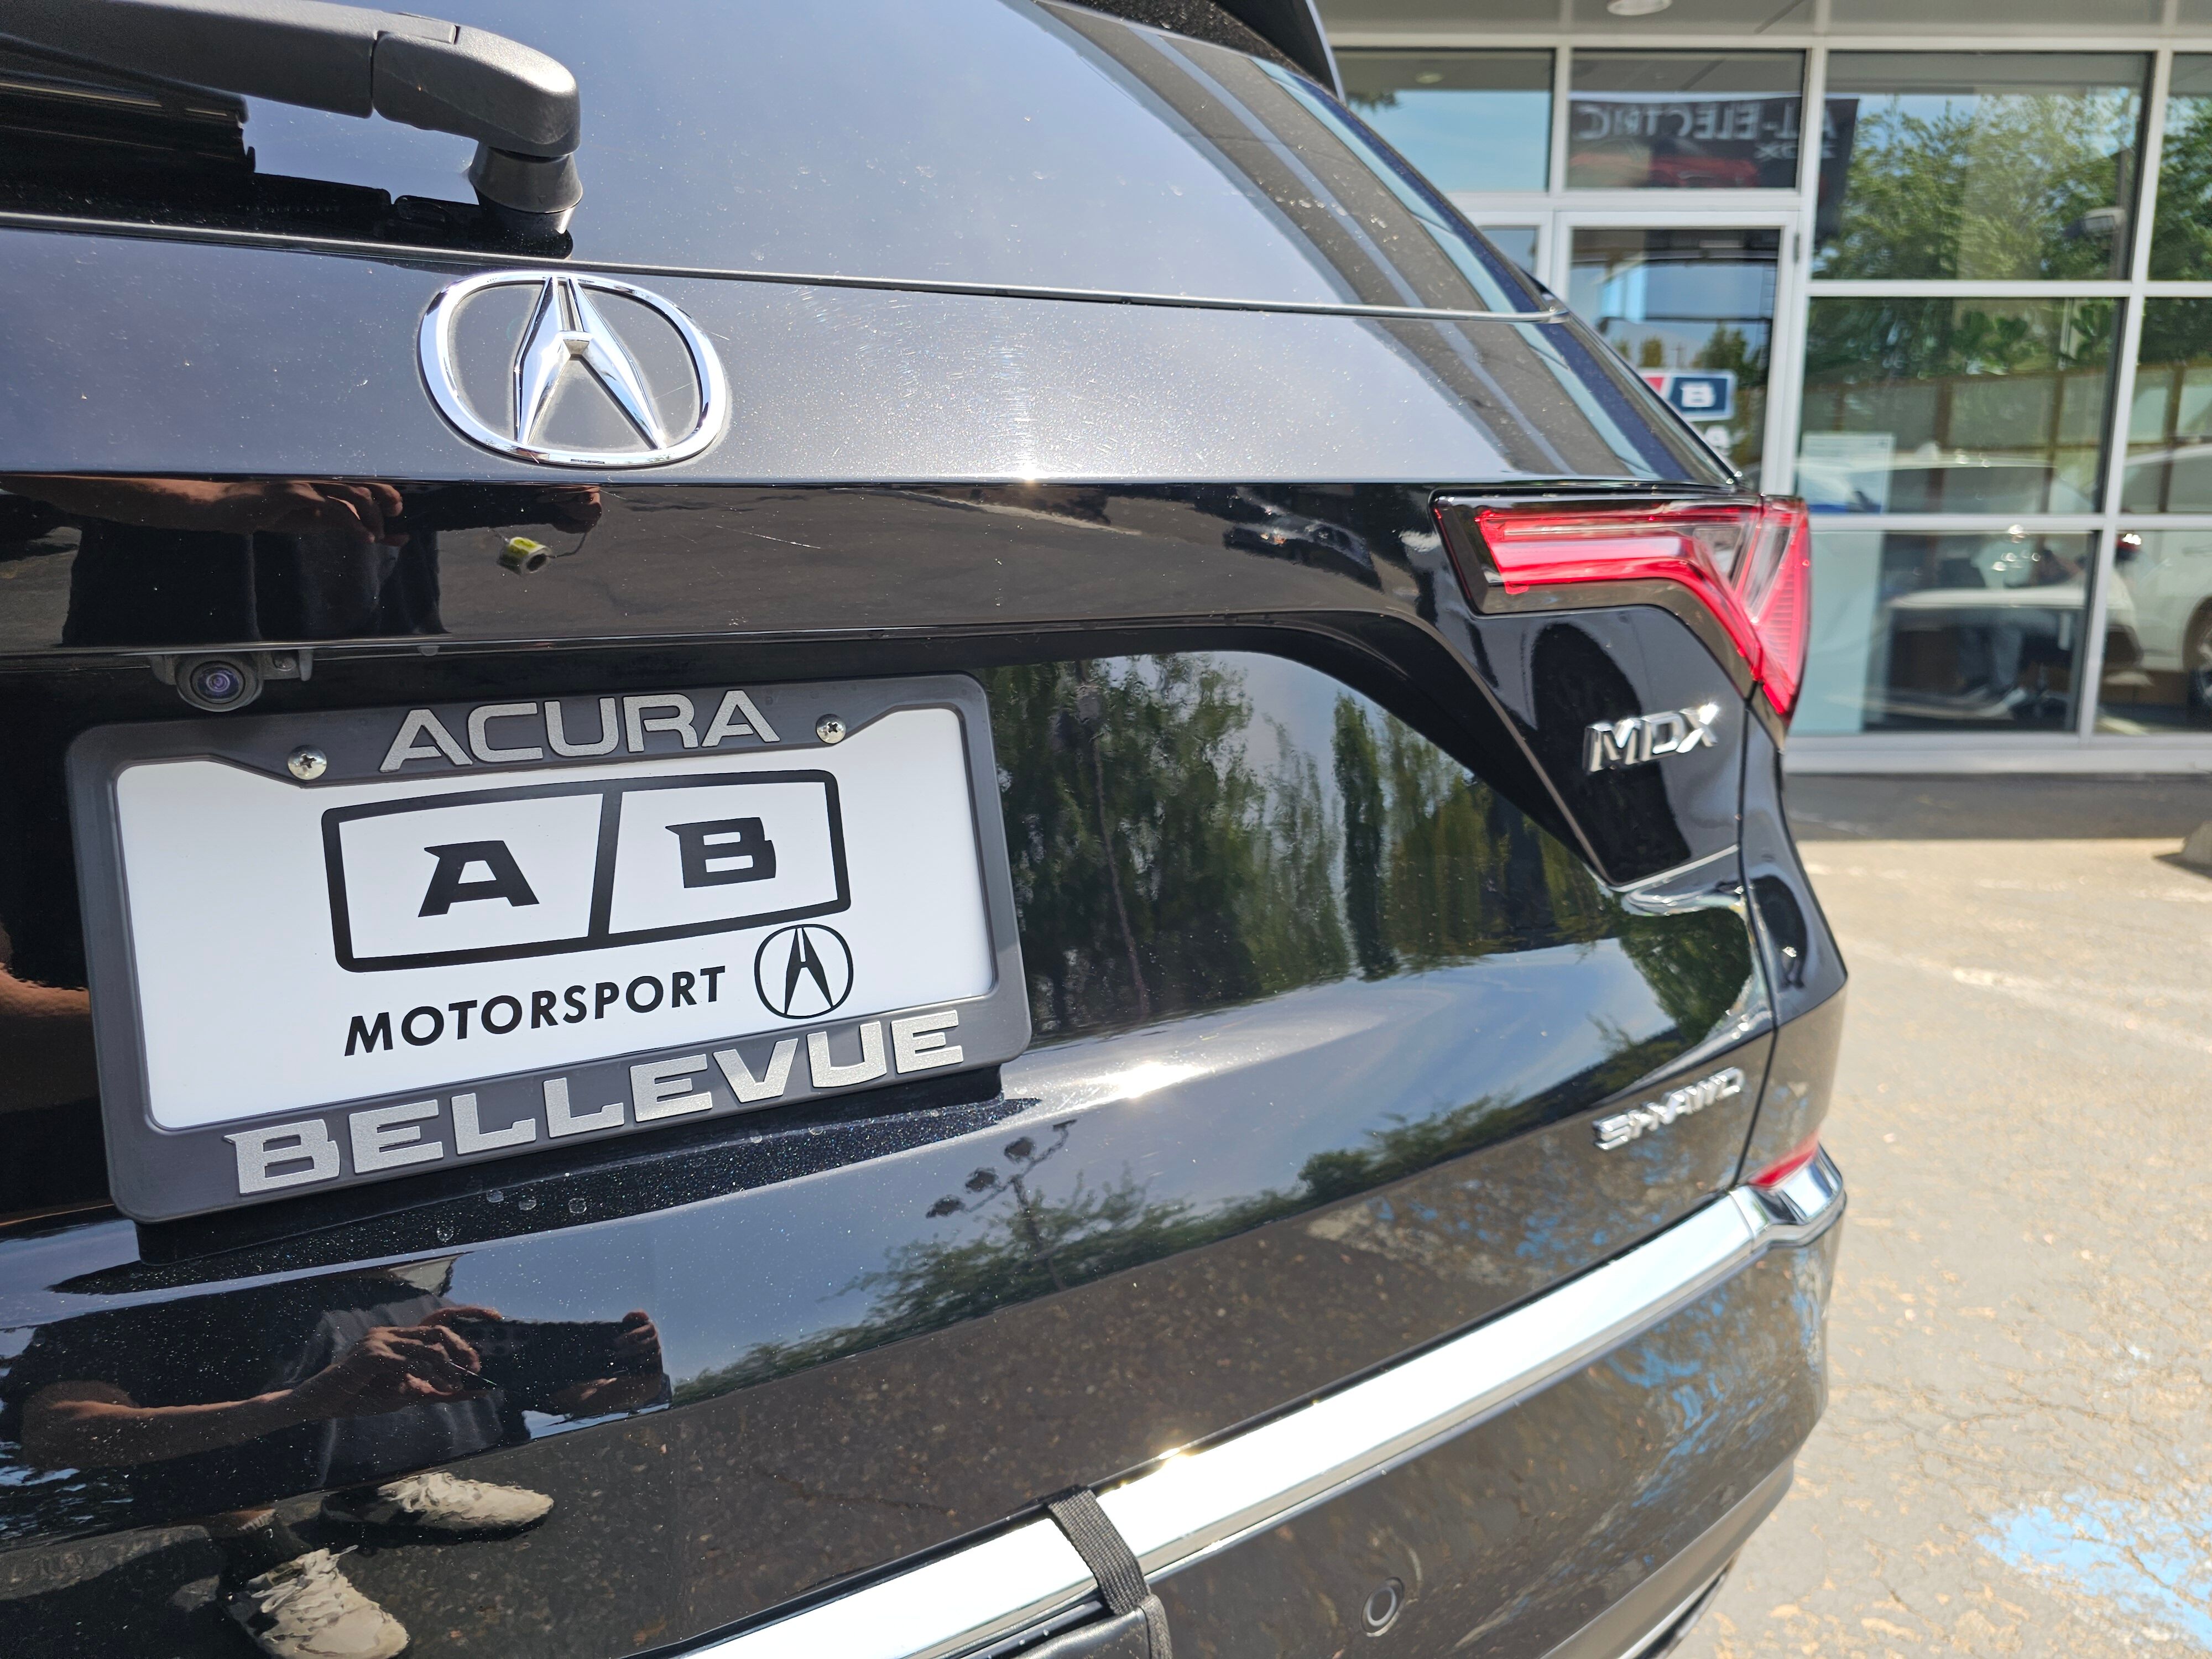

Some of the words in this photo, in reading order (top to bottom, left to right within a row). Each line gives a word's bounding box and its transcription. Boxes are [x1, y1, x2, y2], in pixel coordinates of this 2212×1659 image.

[1681, 380, 1716, 408] B
[379, 689, 781, 773] ACURA
[1583, 703, 1719, 772] MDX
[344, 965, 726, 1056] MOTORSPORT
[223, 1010, 964, 1195] BELLEVUE
